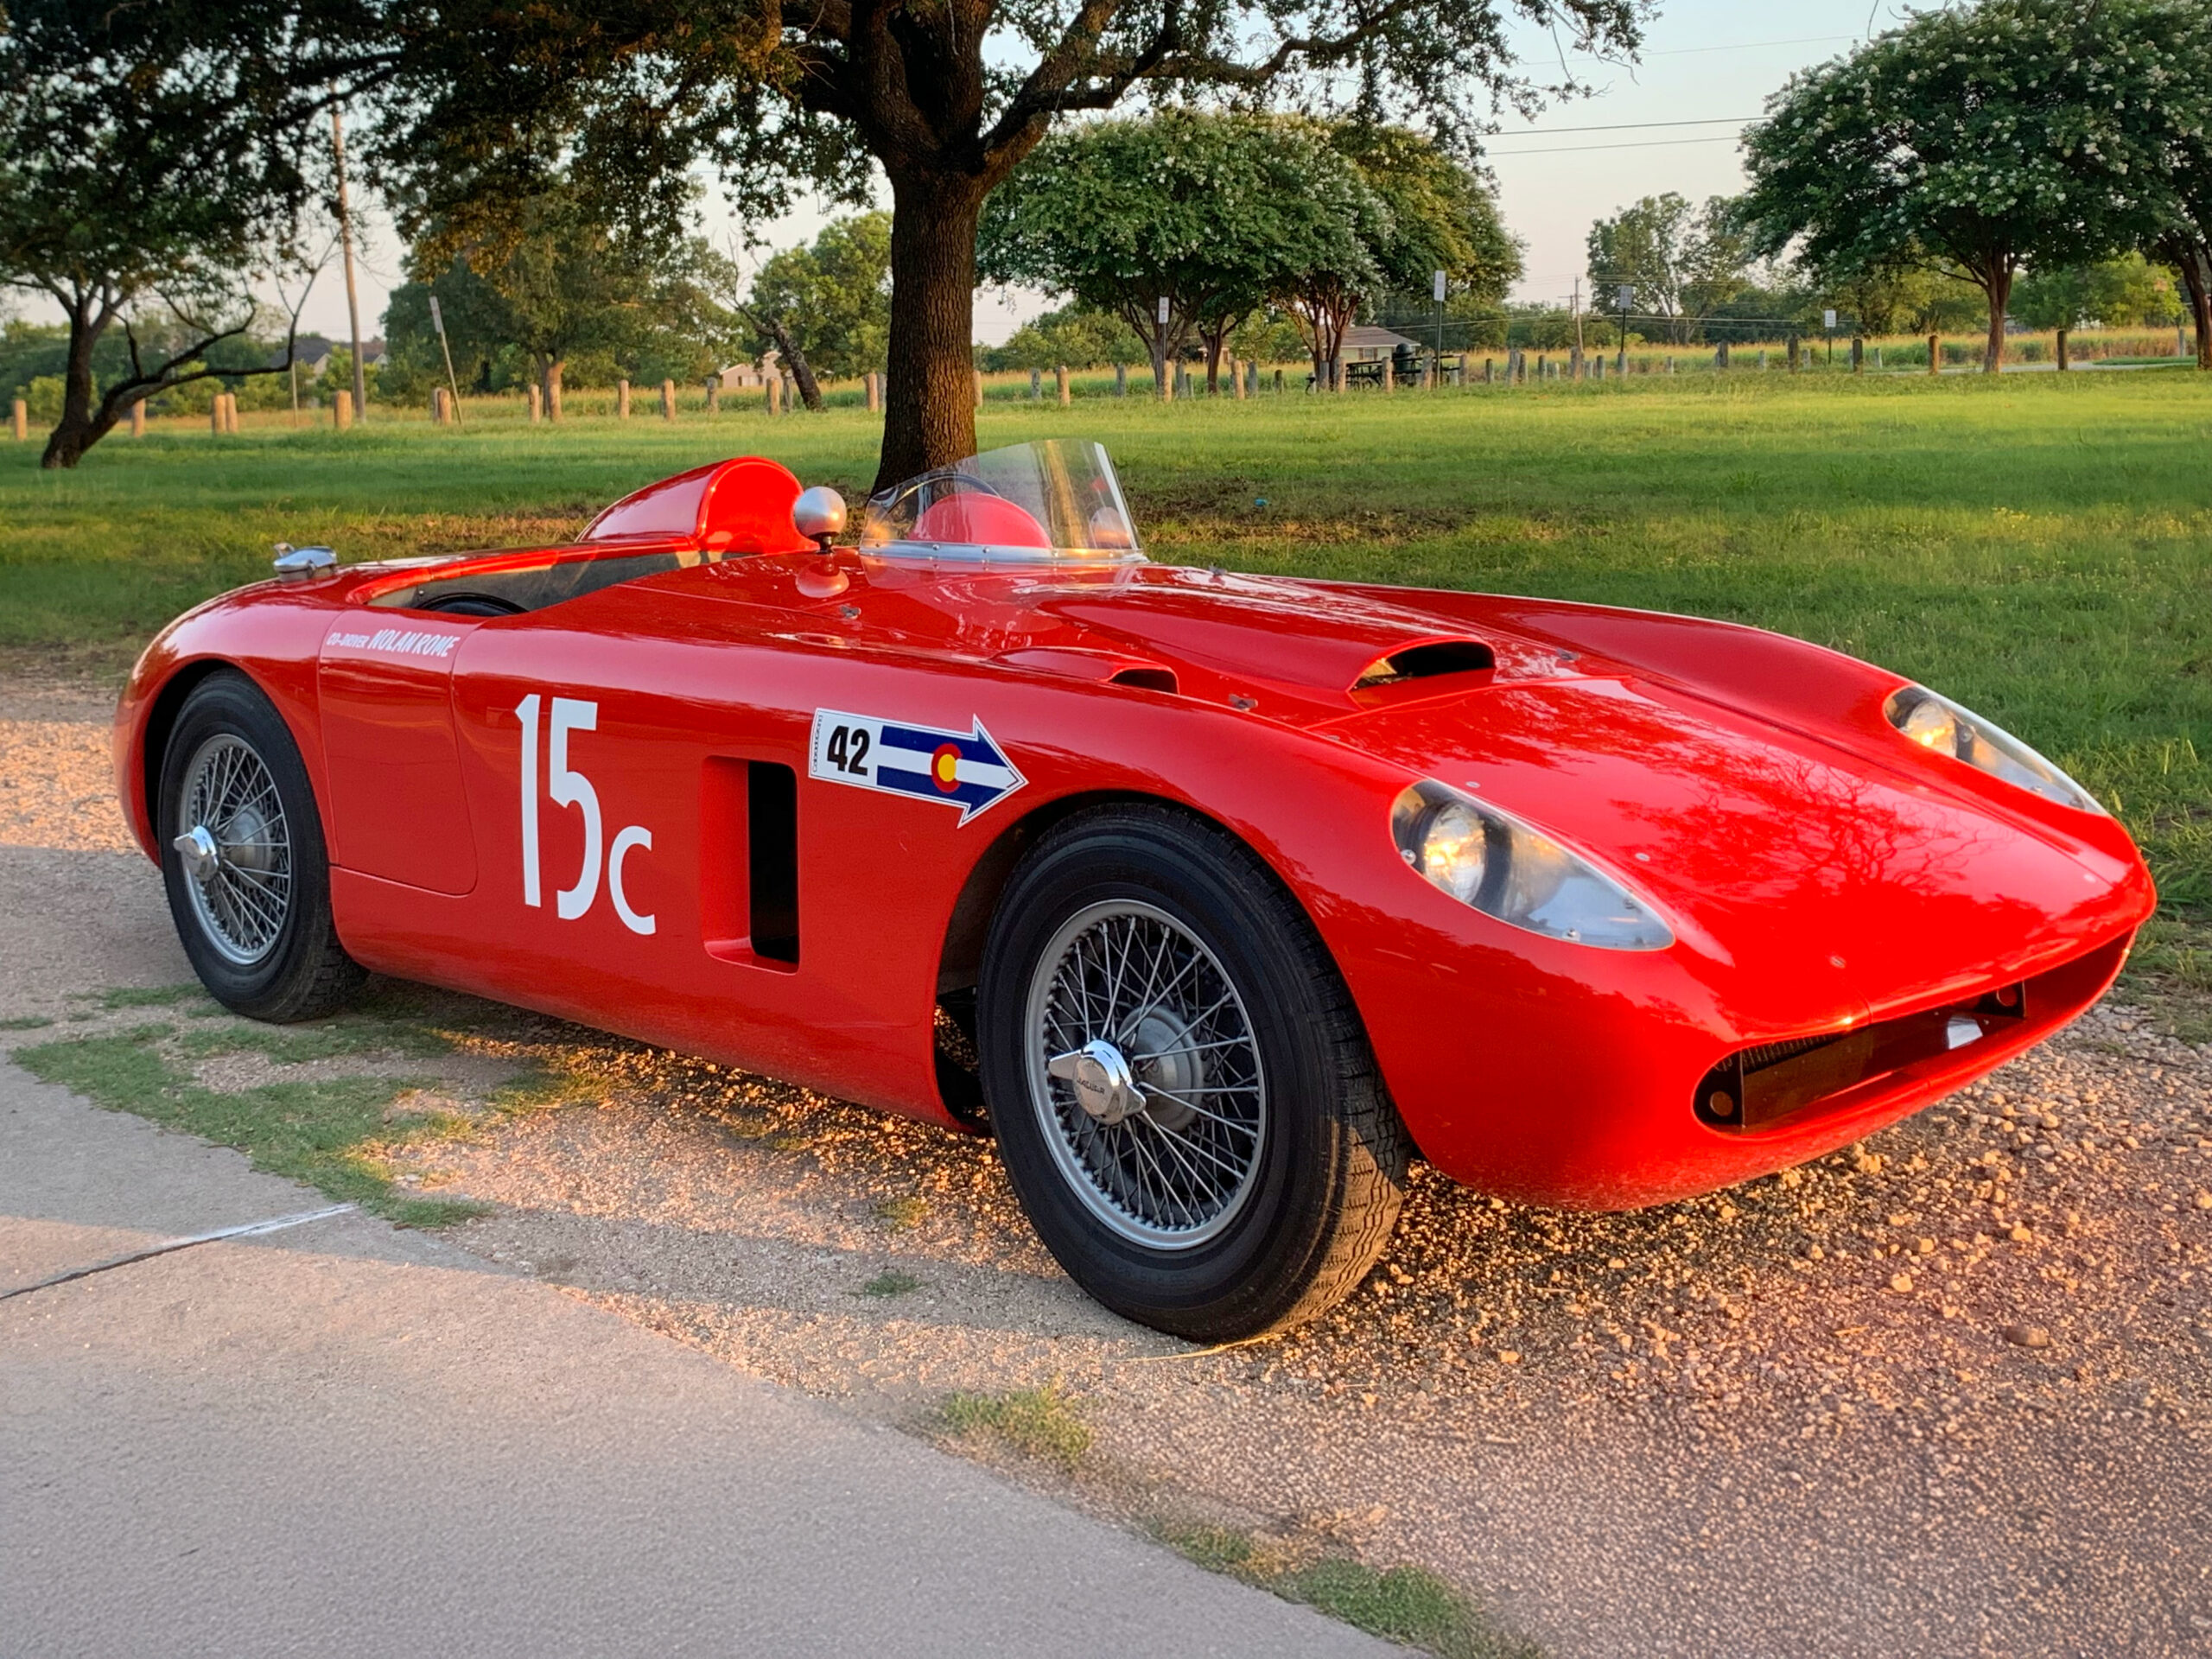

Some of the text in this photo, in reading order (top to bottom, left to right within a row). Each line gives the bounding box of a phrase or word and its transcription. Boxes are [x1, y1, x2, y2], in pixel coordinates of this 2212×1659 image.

[326, 629, 461, 658] CO-DRIVER NOLAN ROME
[827, 725, 870, 777] 42
